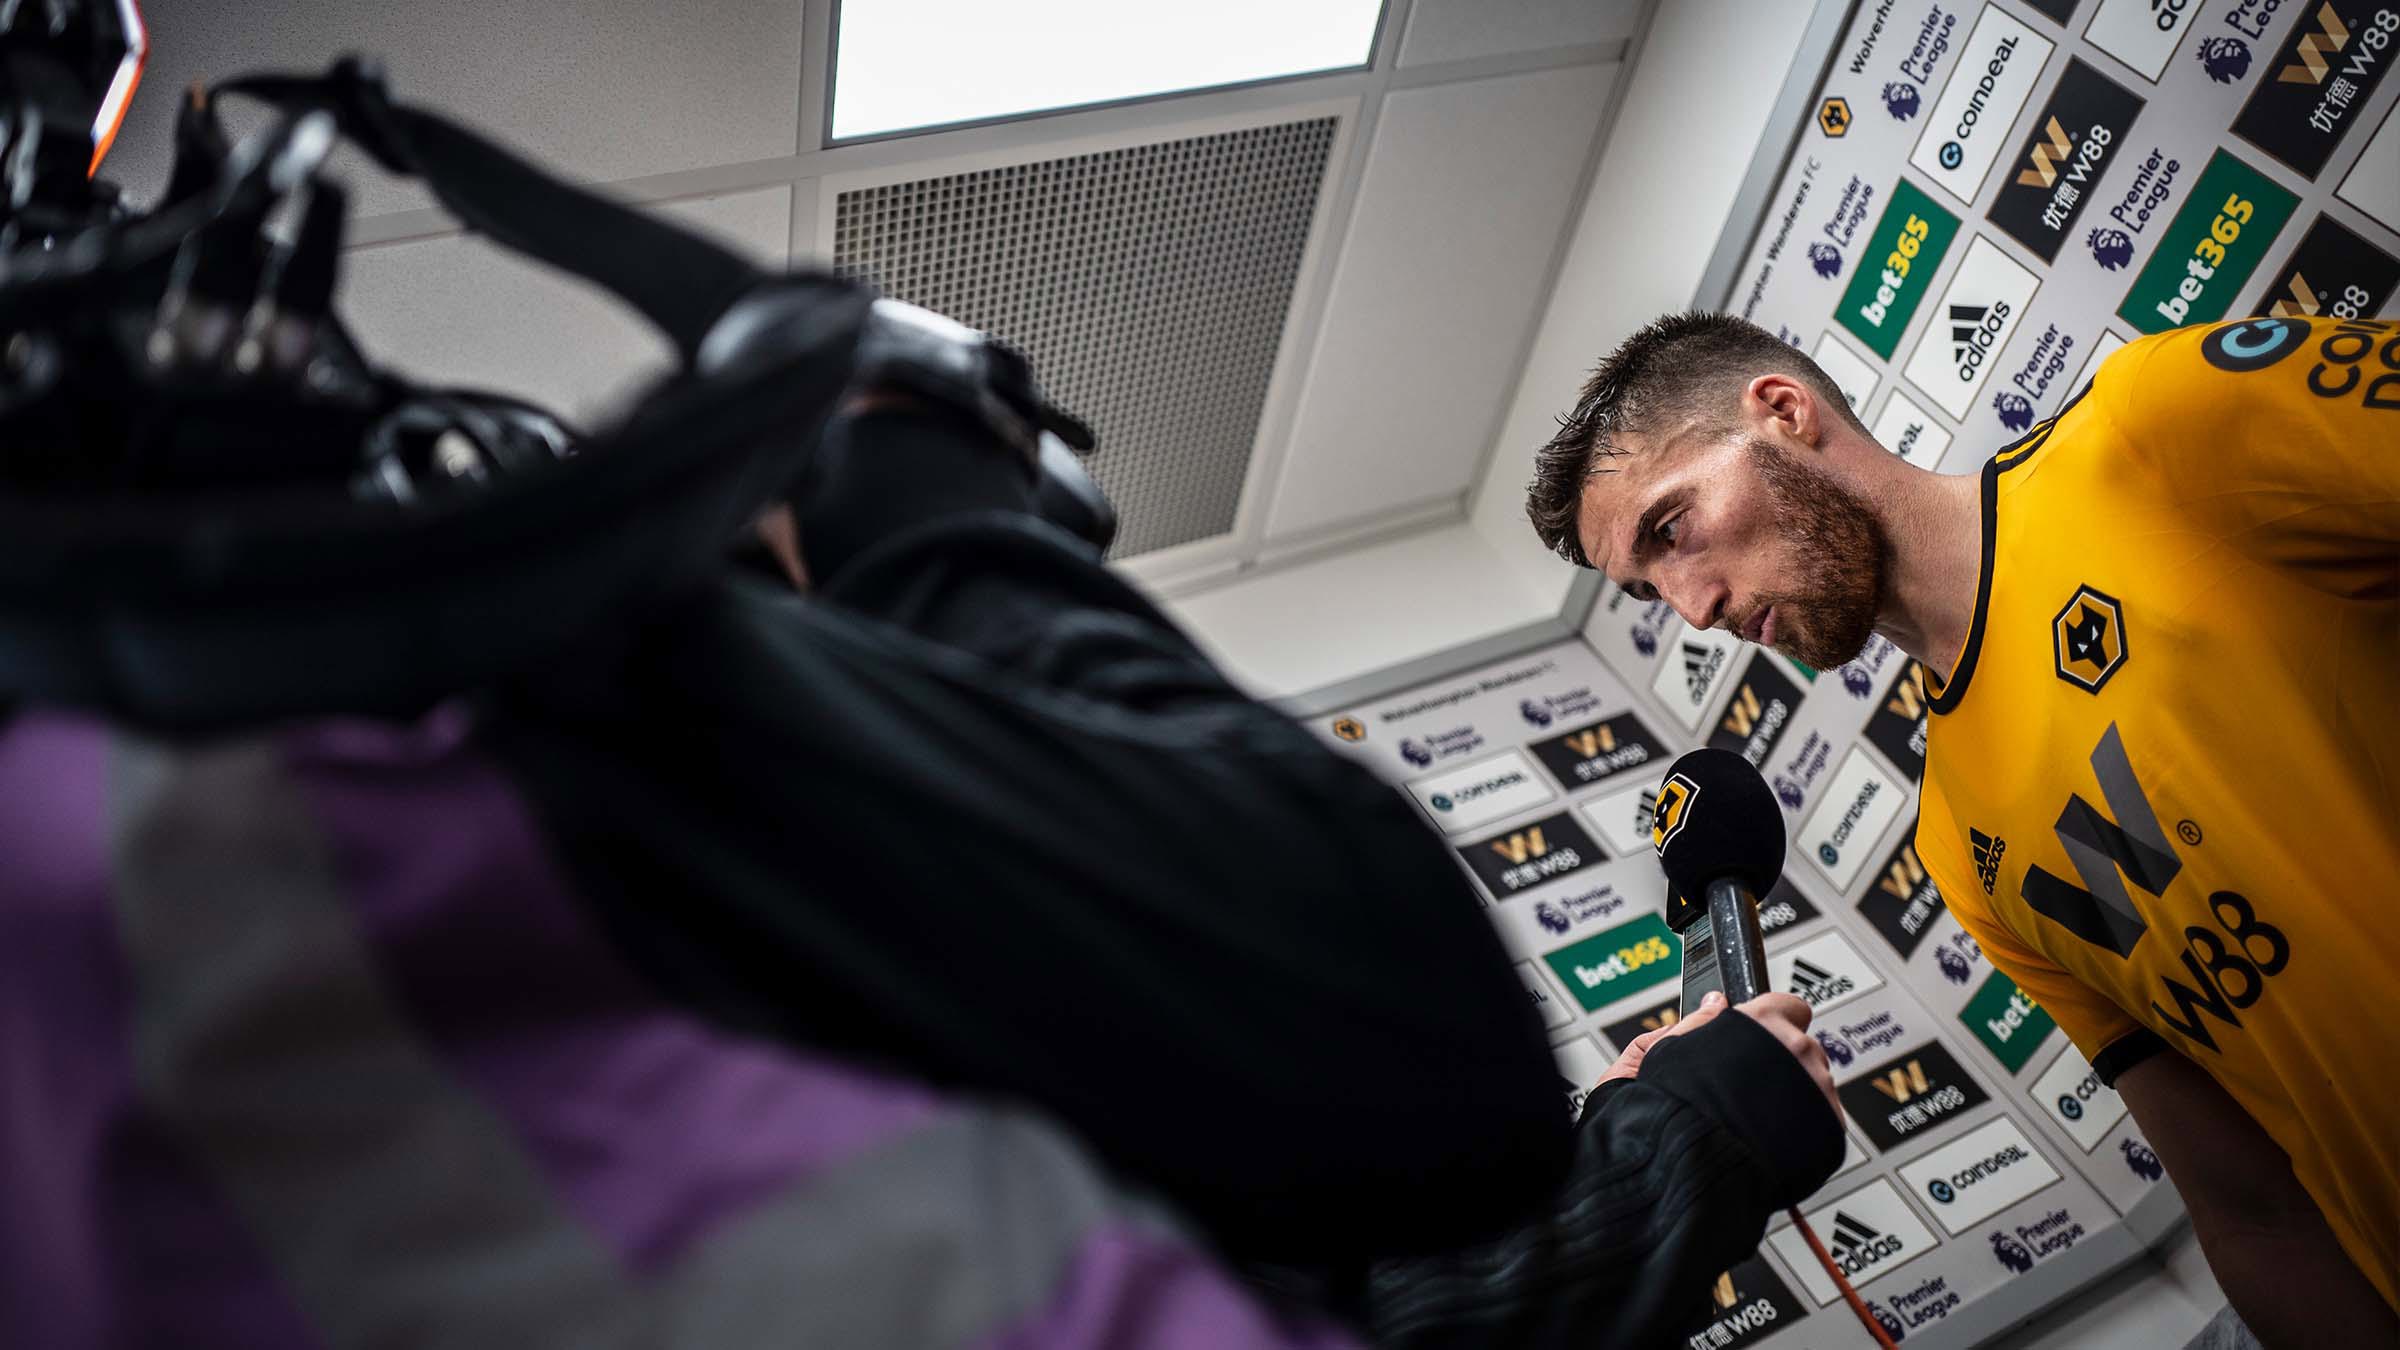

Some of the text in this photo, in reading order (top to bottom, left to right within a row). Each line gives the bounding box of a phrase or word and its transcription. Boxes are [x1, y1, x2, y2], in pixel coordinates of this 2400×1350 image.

[1899, 4, 1942, 76] Premier
[1913, 14, 1957, 86] League
[2342, 8, 2400, 77] W88
[2067, 124, 2112, 184] W88
[2110, 147, 2164, 224] Premier
[1823, 174, 1863, 238] Premier
[1833, 184, 1875, 249] League
[2126, 158, 2180, 234] League
[1860, 213, 1930, 328] bet365
[2156, 193, 2254, 326] bet365
[1959, 300, 2011, 383] adidas
[2013, 323, 2060, 391] Premier
[2027, 334, 2075, 402] League
[1983, 836, 2007, 896] adidas
[1574, 936, 1671, 989] bet365
[2151, 890, 2290, 1055] W88
[1840, 1011, 1891, 1039] Premier
[1850, 1024, 1904, 1053] League
[1920, 1085, 1966, 1118] W88
[2015, 1208, 2071, 1243] Premier
[2028, 1223, 2085, 1257] League
[1724, 1298, 1777, 1336] W88
[1888, 1275, 1947, 1313] Premier
[1901, 1290, 1961, 1329] League
